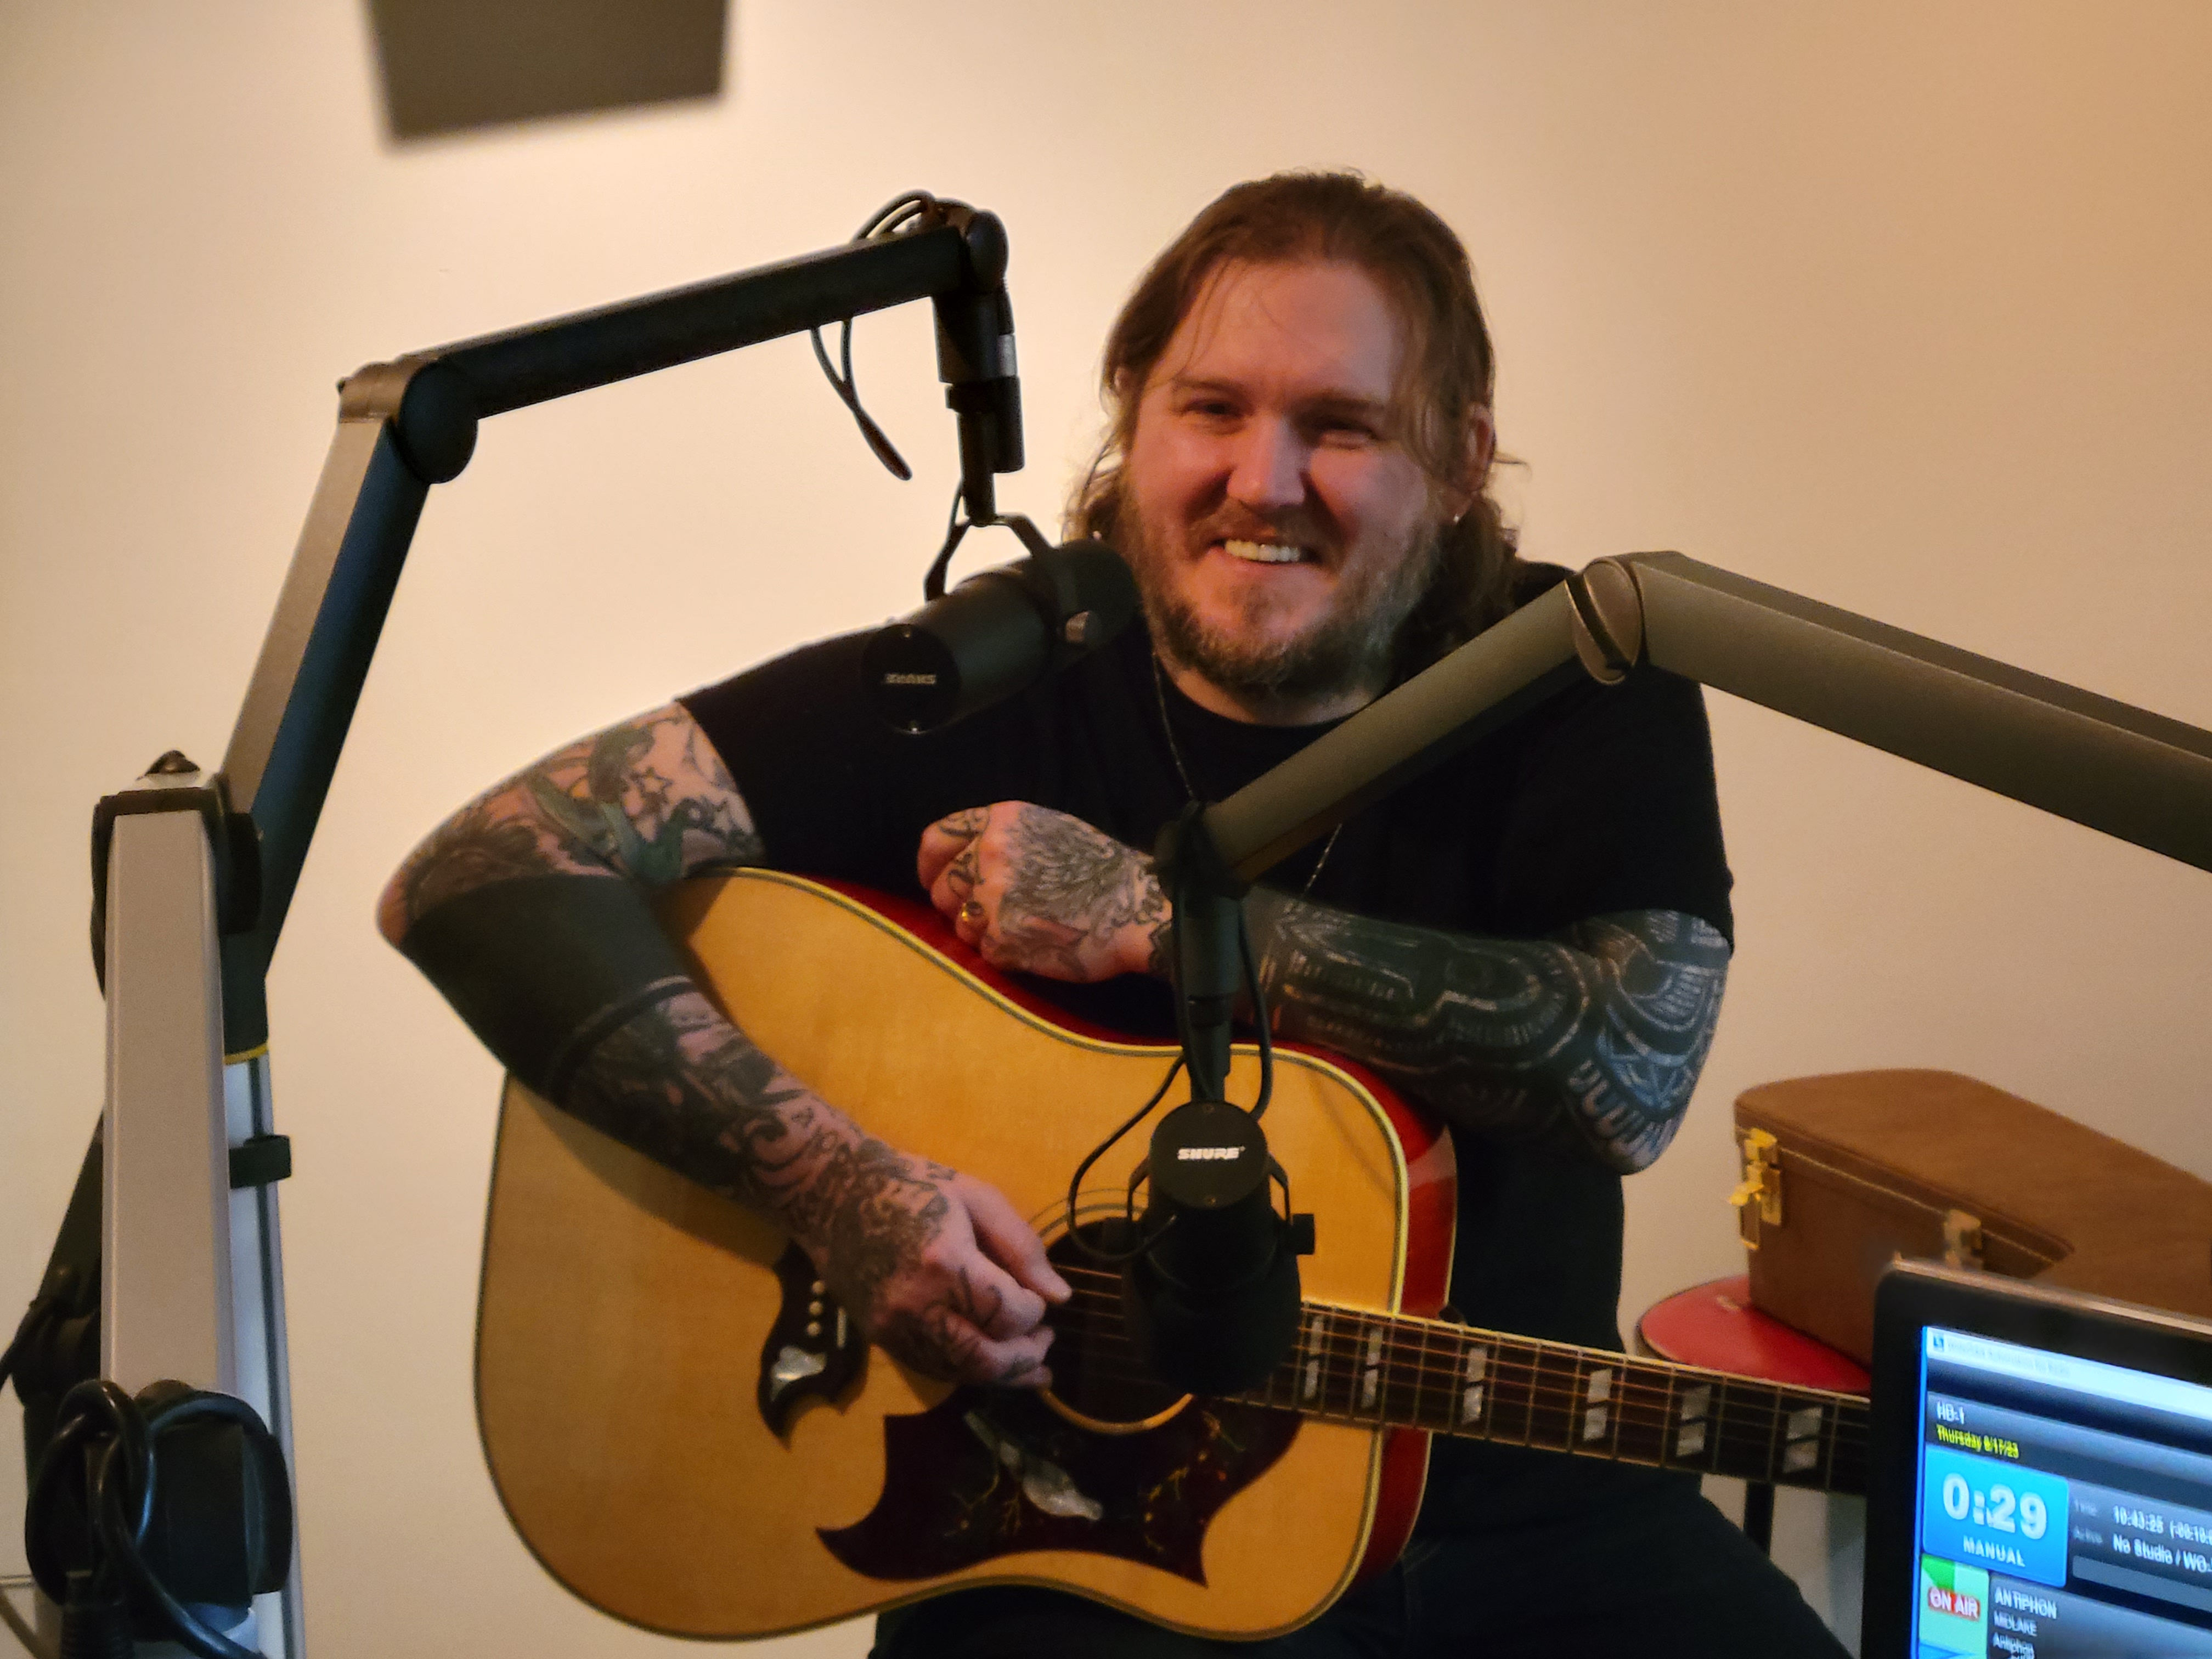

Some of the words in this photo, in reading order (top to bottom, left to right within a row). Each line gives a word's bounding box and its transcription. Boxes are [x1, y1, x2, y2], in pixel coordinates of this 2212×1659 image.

[1178, 1147, 1240, 1161] SHURE
[1936, 1424, 1982, 1452] Thursday
[1943, 1473, 2047, 1540] 0:29
[1963, 1536, 2026, 1567] MANUAL
[2113, 1533, 2131, 1554] No
[2134, 1539, 2173, 1565] Studio
[1929, 1588, 1951, 1611] ON
[1954, 1594, 1978, 1619] AIR
[1995, 1586, 2057, 1619] ANTIPHON
